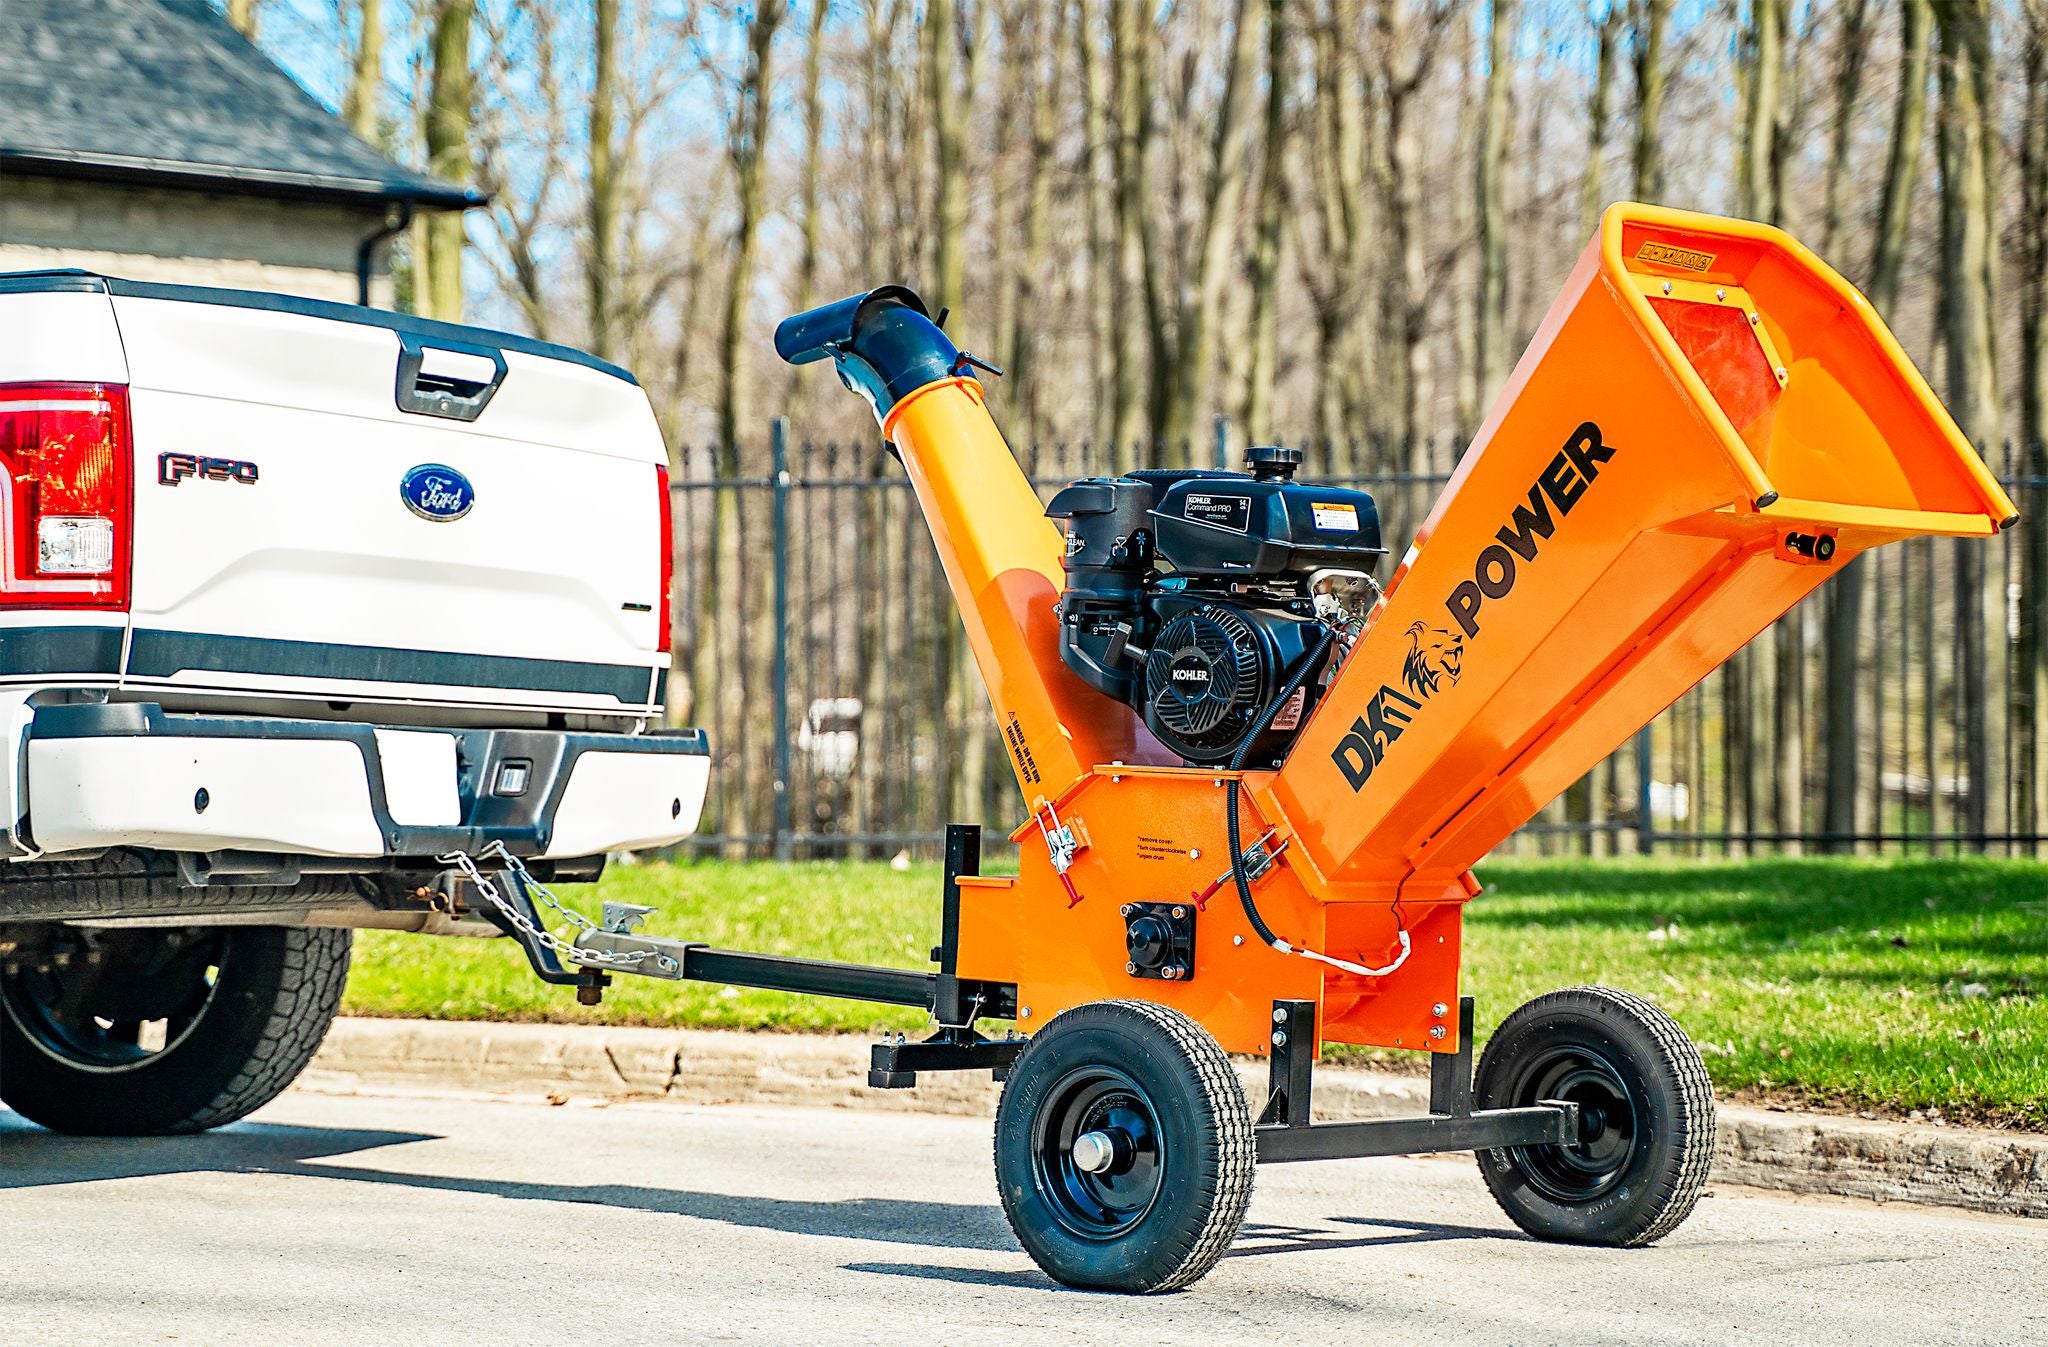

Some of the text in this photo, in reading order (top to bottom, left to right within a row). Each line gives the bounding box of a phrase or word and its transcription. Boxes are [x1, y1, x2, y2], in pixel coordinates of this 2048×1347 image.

[421, 476, 463, 511] Ford
[1188, 496, 1212, 505] KOHLER
[1187, 503, 1217, 512] Command
[1217, 504, 1232, 513] PRO
[1445, 421, 1617, 639] POWER
[1172, 669, 1209, 681] KOHLER
[1012, 719, 1026, 746] DANGER
[1006, 725, 1032, 784] ENGINE WHILE OPEN
[1023, 747, 1031, 758] DO
[1027, 756, 1036, 770] NOT
[1031, 769, 1041, 784] RUN
